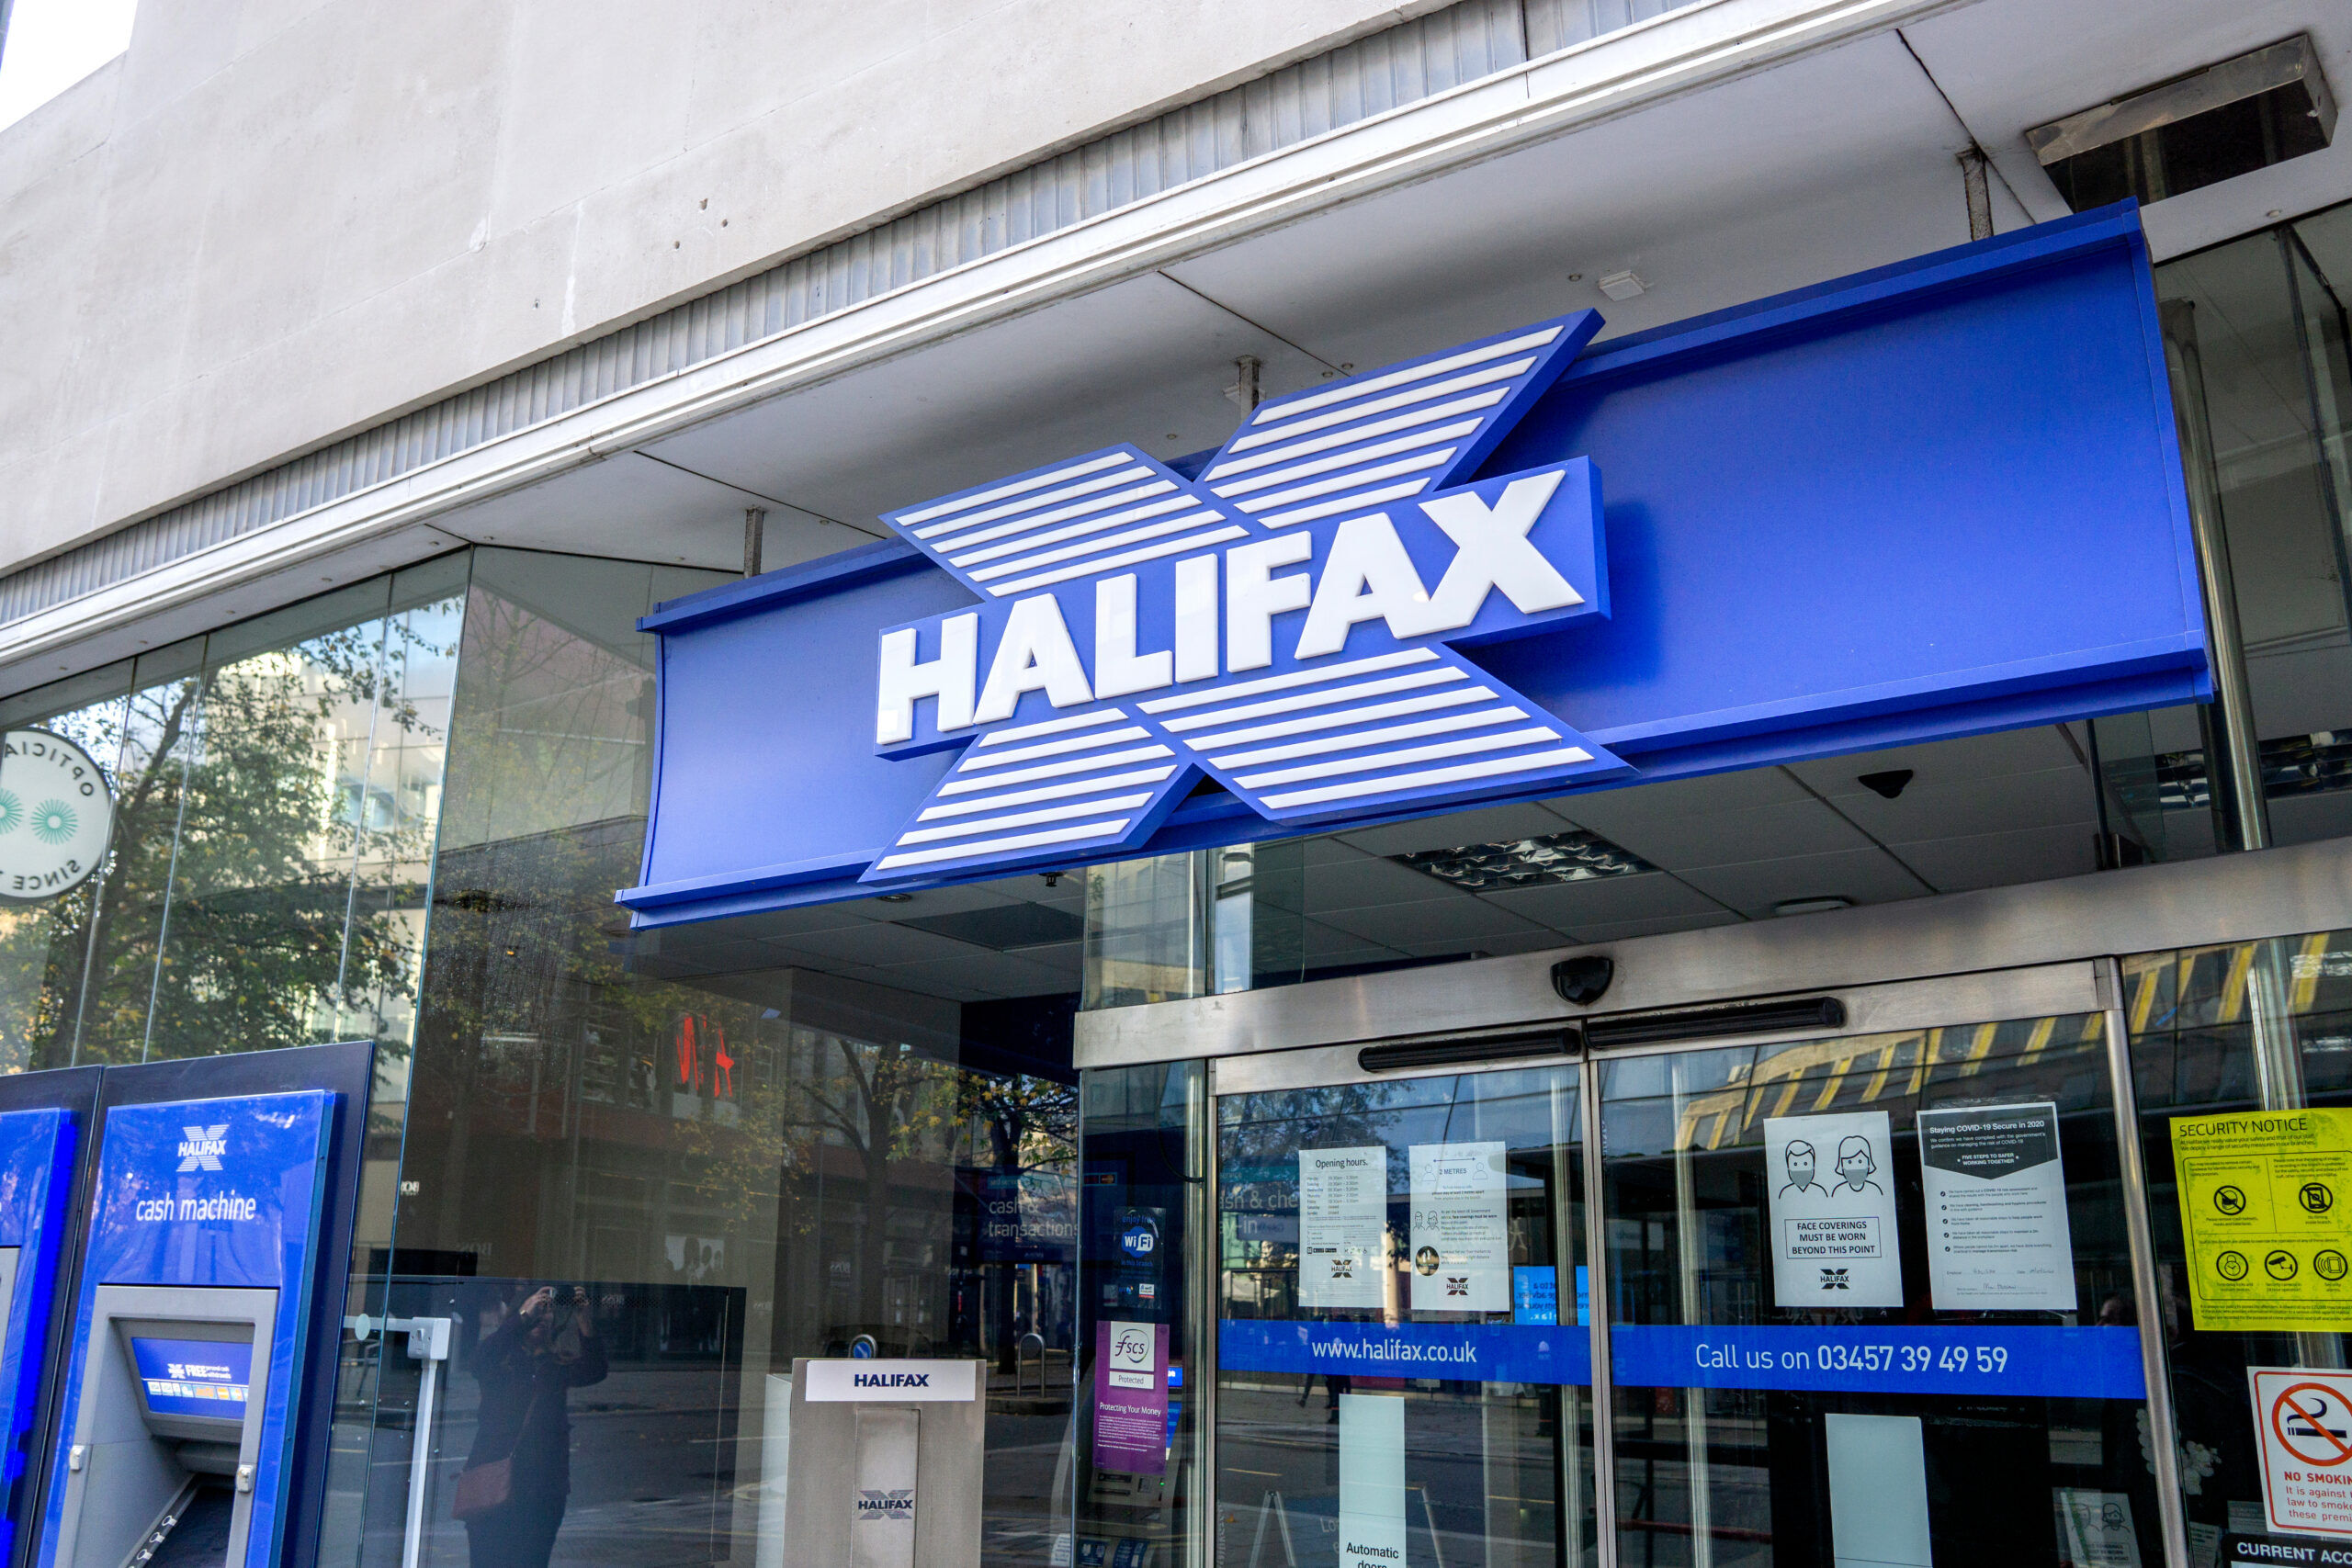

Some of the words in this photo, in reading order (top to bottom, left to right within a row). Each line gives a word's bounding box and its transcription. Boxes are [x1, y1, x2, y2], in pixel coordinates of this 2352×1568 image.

[876, 468, 1586, 746] HALIFAX
[1929, 1126, 1955, 1134] Staying
[1956, 1123, 1991, 1132] COVID-19
[2027, 1120, 2044, 1128] 2020
[2179, 1121, 2248, 1137] SECURITY
[2251, 1118, 2308, 1133] NOTICE
[177, 1139, 228, 1157] HALIFAX
[1315, 1158, 1345, 1169] Opening
[1345, 1157, 1368, 1167] hours.
[135, 1191, 175, 1222] cash
[179, 1189, 256, 1221] machine
[989, 1196, 1023, 1213] cash
[1027, 1202, 1038, 1213] &
[1250, 1190, 1263, 1209] &
[1122, 1215, 1139, 1224] enjoy
[1797, 1222, 1816, 1231] FACE
[1818, 1221, 1867, 1230] COVERINGS
[988, 1218, 1079, 1237] transactions
[1799, 1233, 1823, 1241] MUST
[1826, 1233, 1836, 1241] BE
[1838, 1233, 1866, 1241] WORN
[1792, 1246, 1826, 1255] BEYOND
[1828, 1246, 1847, 1254] THIS
[1849, 1245, 1875, 1254] POINT
[1820, 1275, 1849, 1283] HALIFAX
[1312, 1337, 1477, 1363] www.halifax.co.uk
[1695, 1343, 1739, 1369] Call
[1747, 1350, 1774, 1370] us
[1781, 1350, 1810, 1370] on
[1817, 1345, 1894, 1371] 03457
[1900, 1346, 1931, 1372] 39
[1939, 1346, 1969, 1372] 49
[1976, 1346, 2008, 1373] 59
[184, 1364, 208, 1378] FREE
[854, 1373, 930, 1387] HALIFAX
[1118, 1375, 1145, 1384] Protected
[1099, 1402, 1127, 1415] Protecting
[1127, 1404, 1141, 1414] Your
[1141, 1406, 1161, 1416] Money
[2284, 1471, 2301, 1482] NO
[2286, 1485, 2292, 1495] It
[2297, 1486, 2305, 1495] is
[2309, 1487, 2346, 1499] against
[858, 1499, 913, 1510] HALIFAX
[2288, 1497, 2305, 1507] law
[2308, 1498, 2318, 1508] to
[2322, 1500, 2352, 1511] smoke
[2289, 1509, 2316, 1519] these
[2322, 1512, 2352, 1522] premi
[1346, 1541, 1399, 1560] Automatic
[2236, 1541, 2315, 1562] CURRENT
